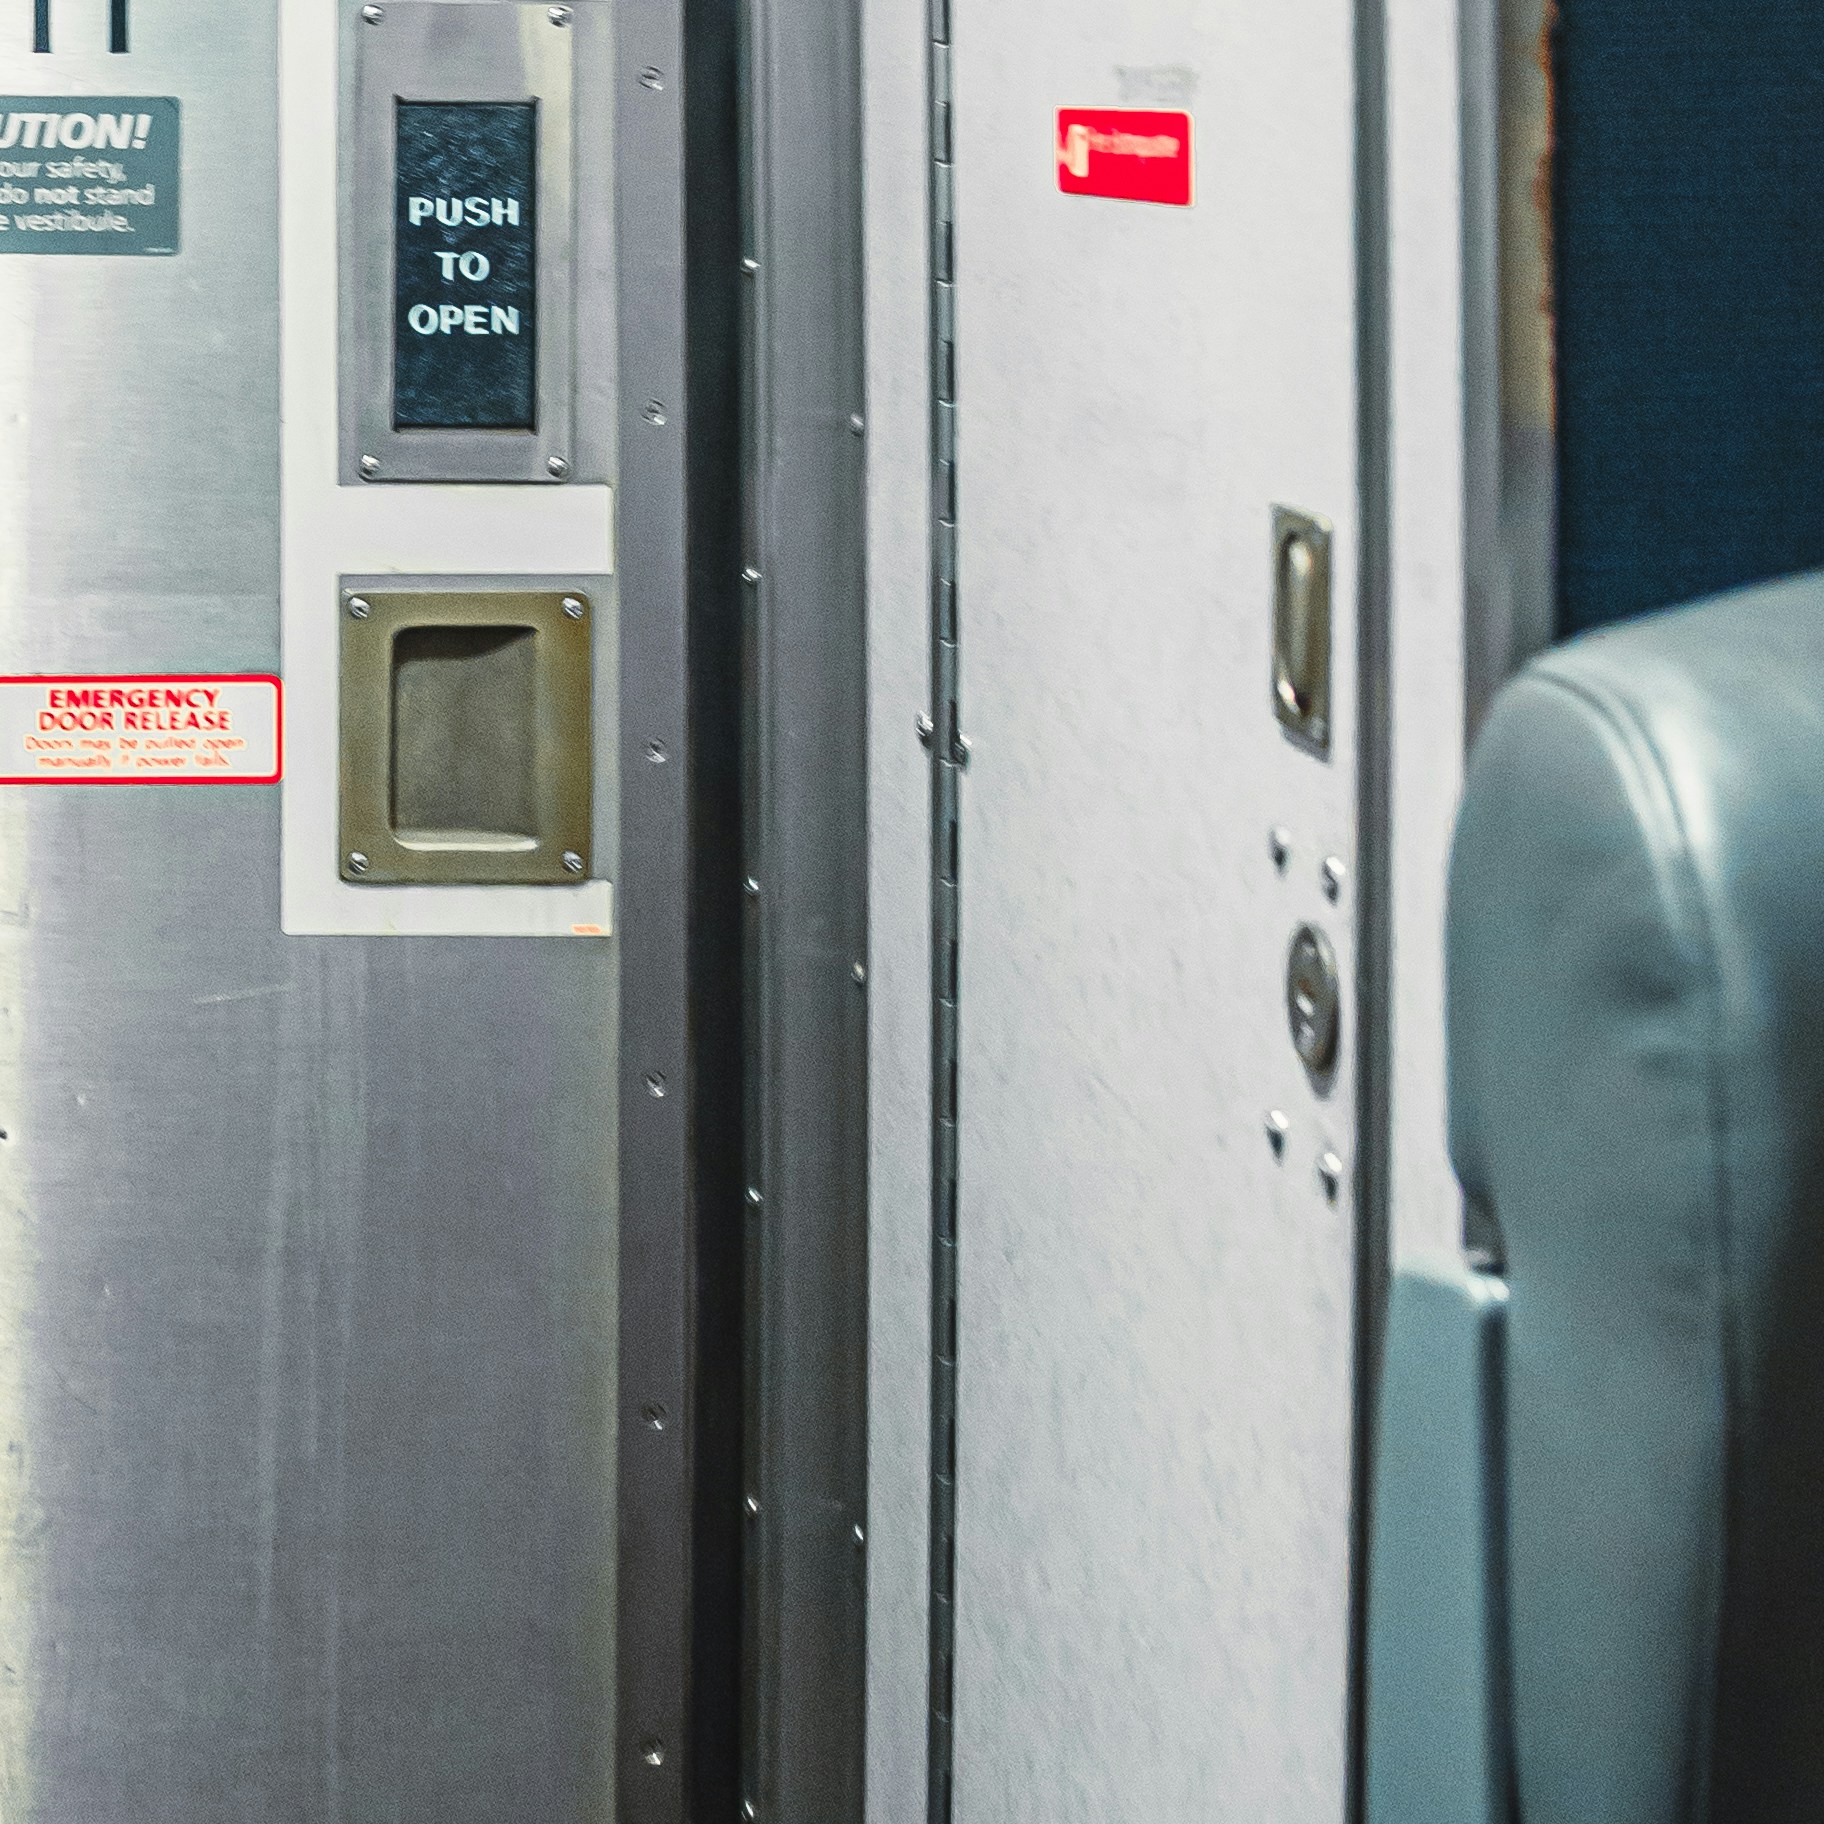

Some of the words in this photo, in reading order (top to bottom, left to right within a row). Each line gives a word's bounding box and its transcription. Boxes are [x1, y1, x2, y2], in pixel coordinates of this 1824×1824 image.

[45, 155, 127, 183] safety,
[33, 184, 80, 205] not
[83, 183, 156, 206] stand
[13, 208, 135, 233] vestibule.
[407, 195, 520, 228] PUSH
[432, 250, 490, 282] TO
[406, 302, 521, 336] OPEN
[48, 688, 220, 709] EMERGENCY
[37, 711, 115, 731] DOOR
[123, 710, 232, 731] RELEASE
[118, 736, 139, 751] be
[202, 737, 246, 754] open
